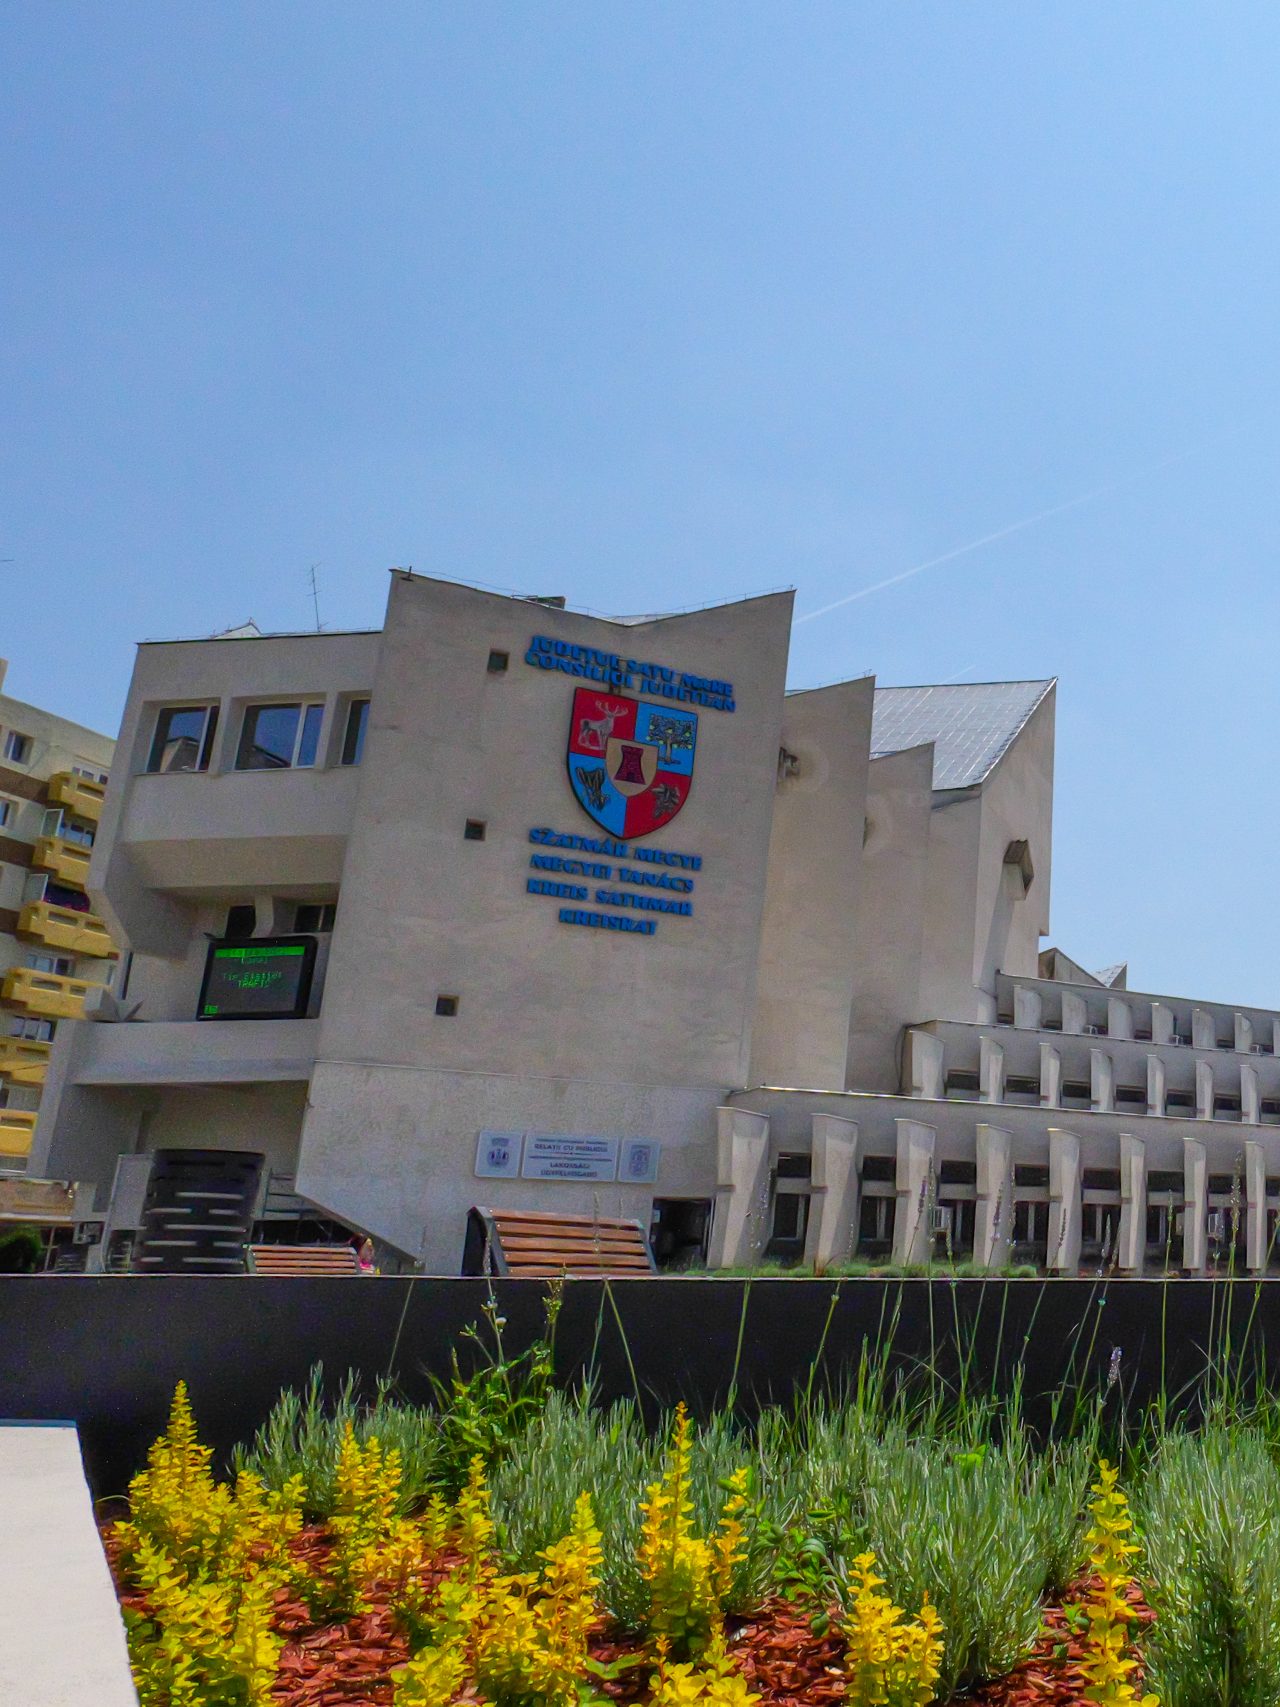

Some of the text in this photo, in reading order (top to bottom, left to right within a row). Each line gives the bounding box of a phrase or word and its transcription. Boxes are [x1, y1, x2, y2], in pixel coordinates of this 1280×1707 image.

[626, 659, 676, 681] SATU
[633, 846, 703, 871] MEGYE
[530, 853, 694, 893] MEGYEI TANÁCS
[527, 878, 693, 917] KREIS SATHMAR
[559, 908, 657, 936] KREISRAT
